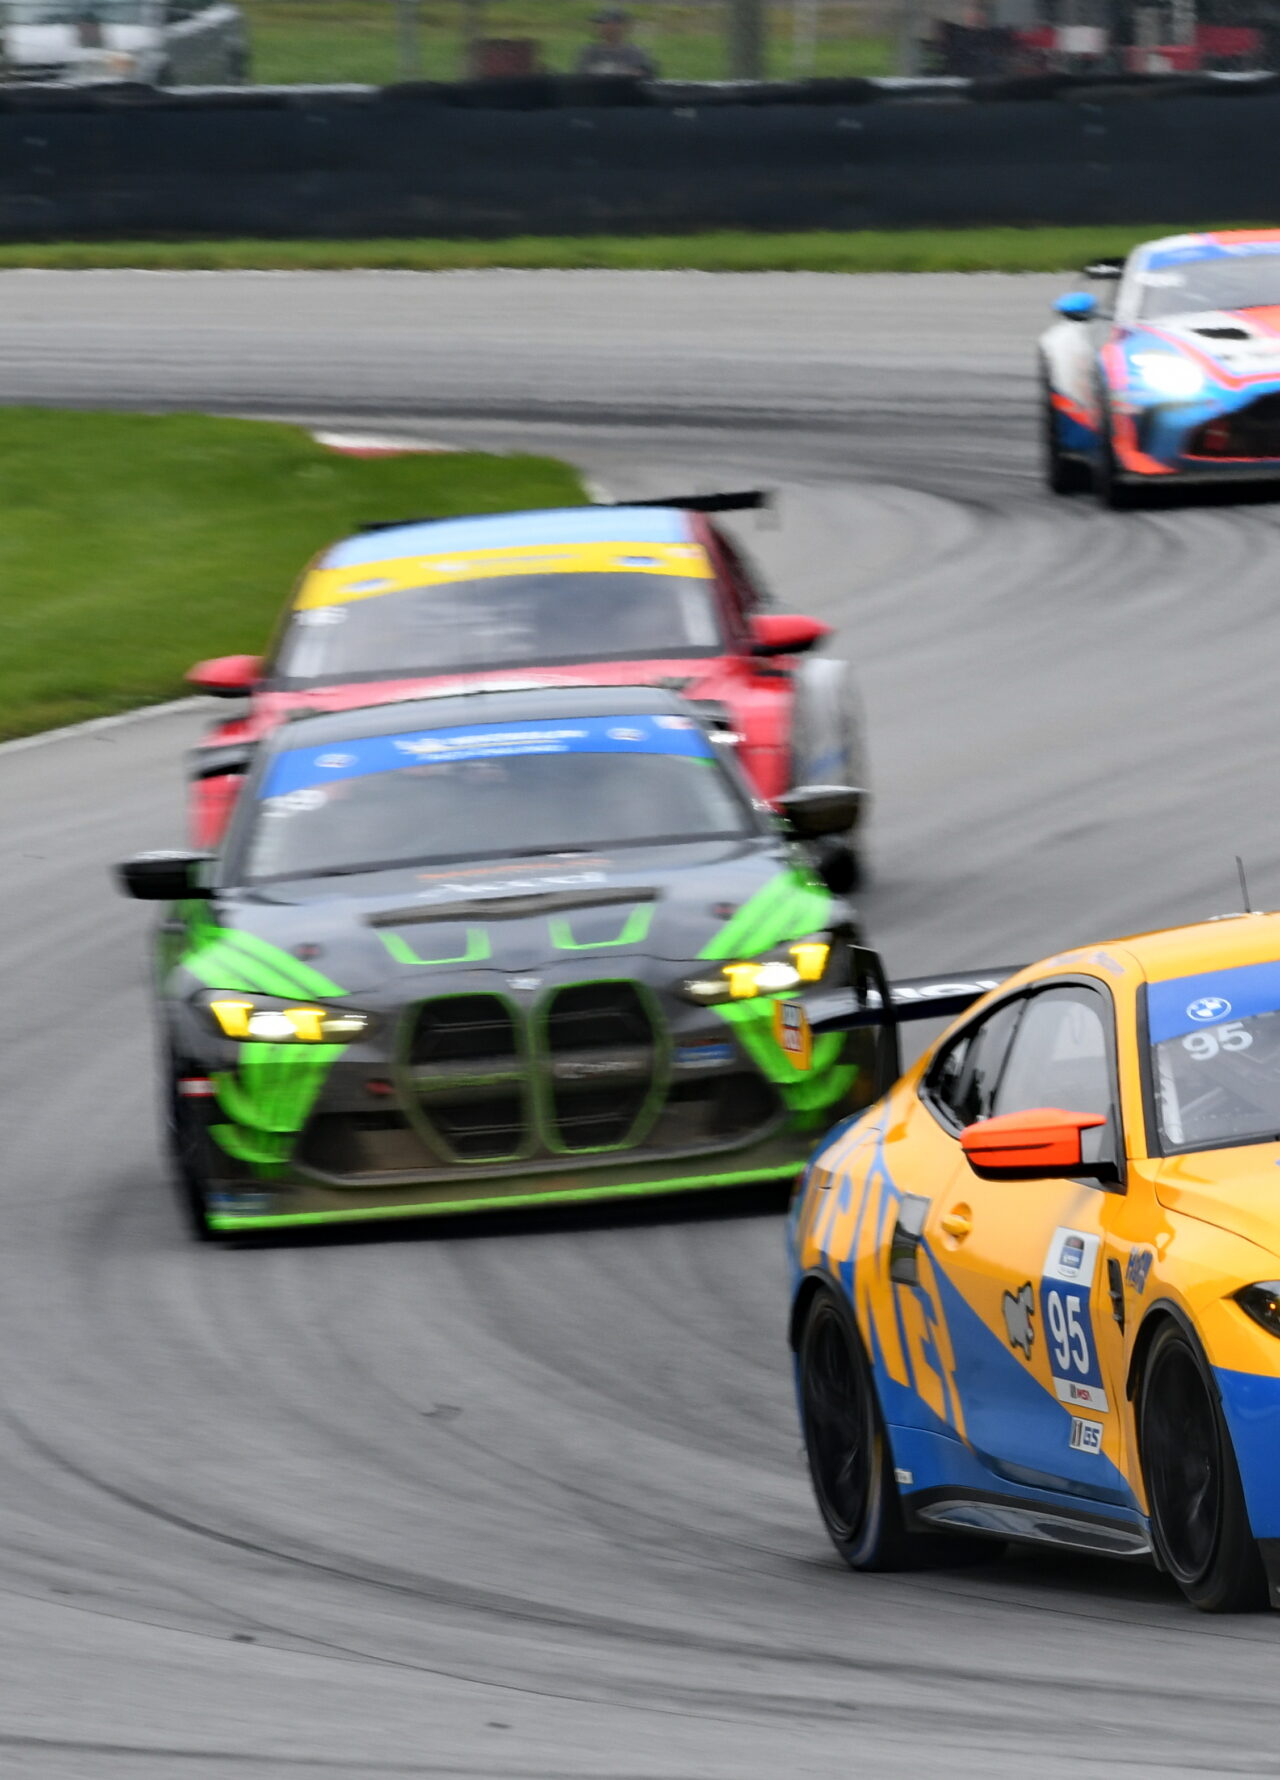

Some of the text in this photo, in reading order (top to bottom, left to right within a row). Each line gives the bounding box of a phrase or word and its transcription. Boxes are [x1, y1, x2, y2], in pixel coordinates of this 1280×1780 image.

[1182, 1022, 1253, 1061] 95
[1048, 1290, 1089, 1375] 95
[1083, 1425, 1099, 1447] GS
